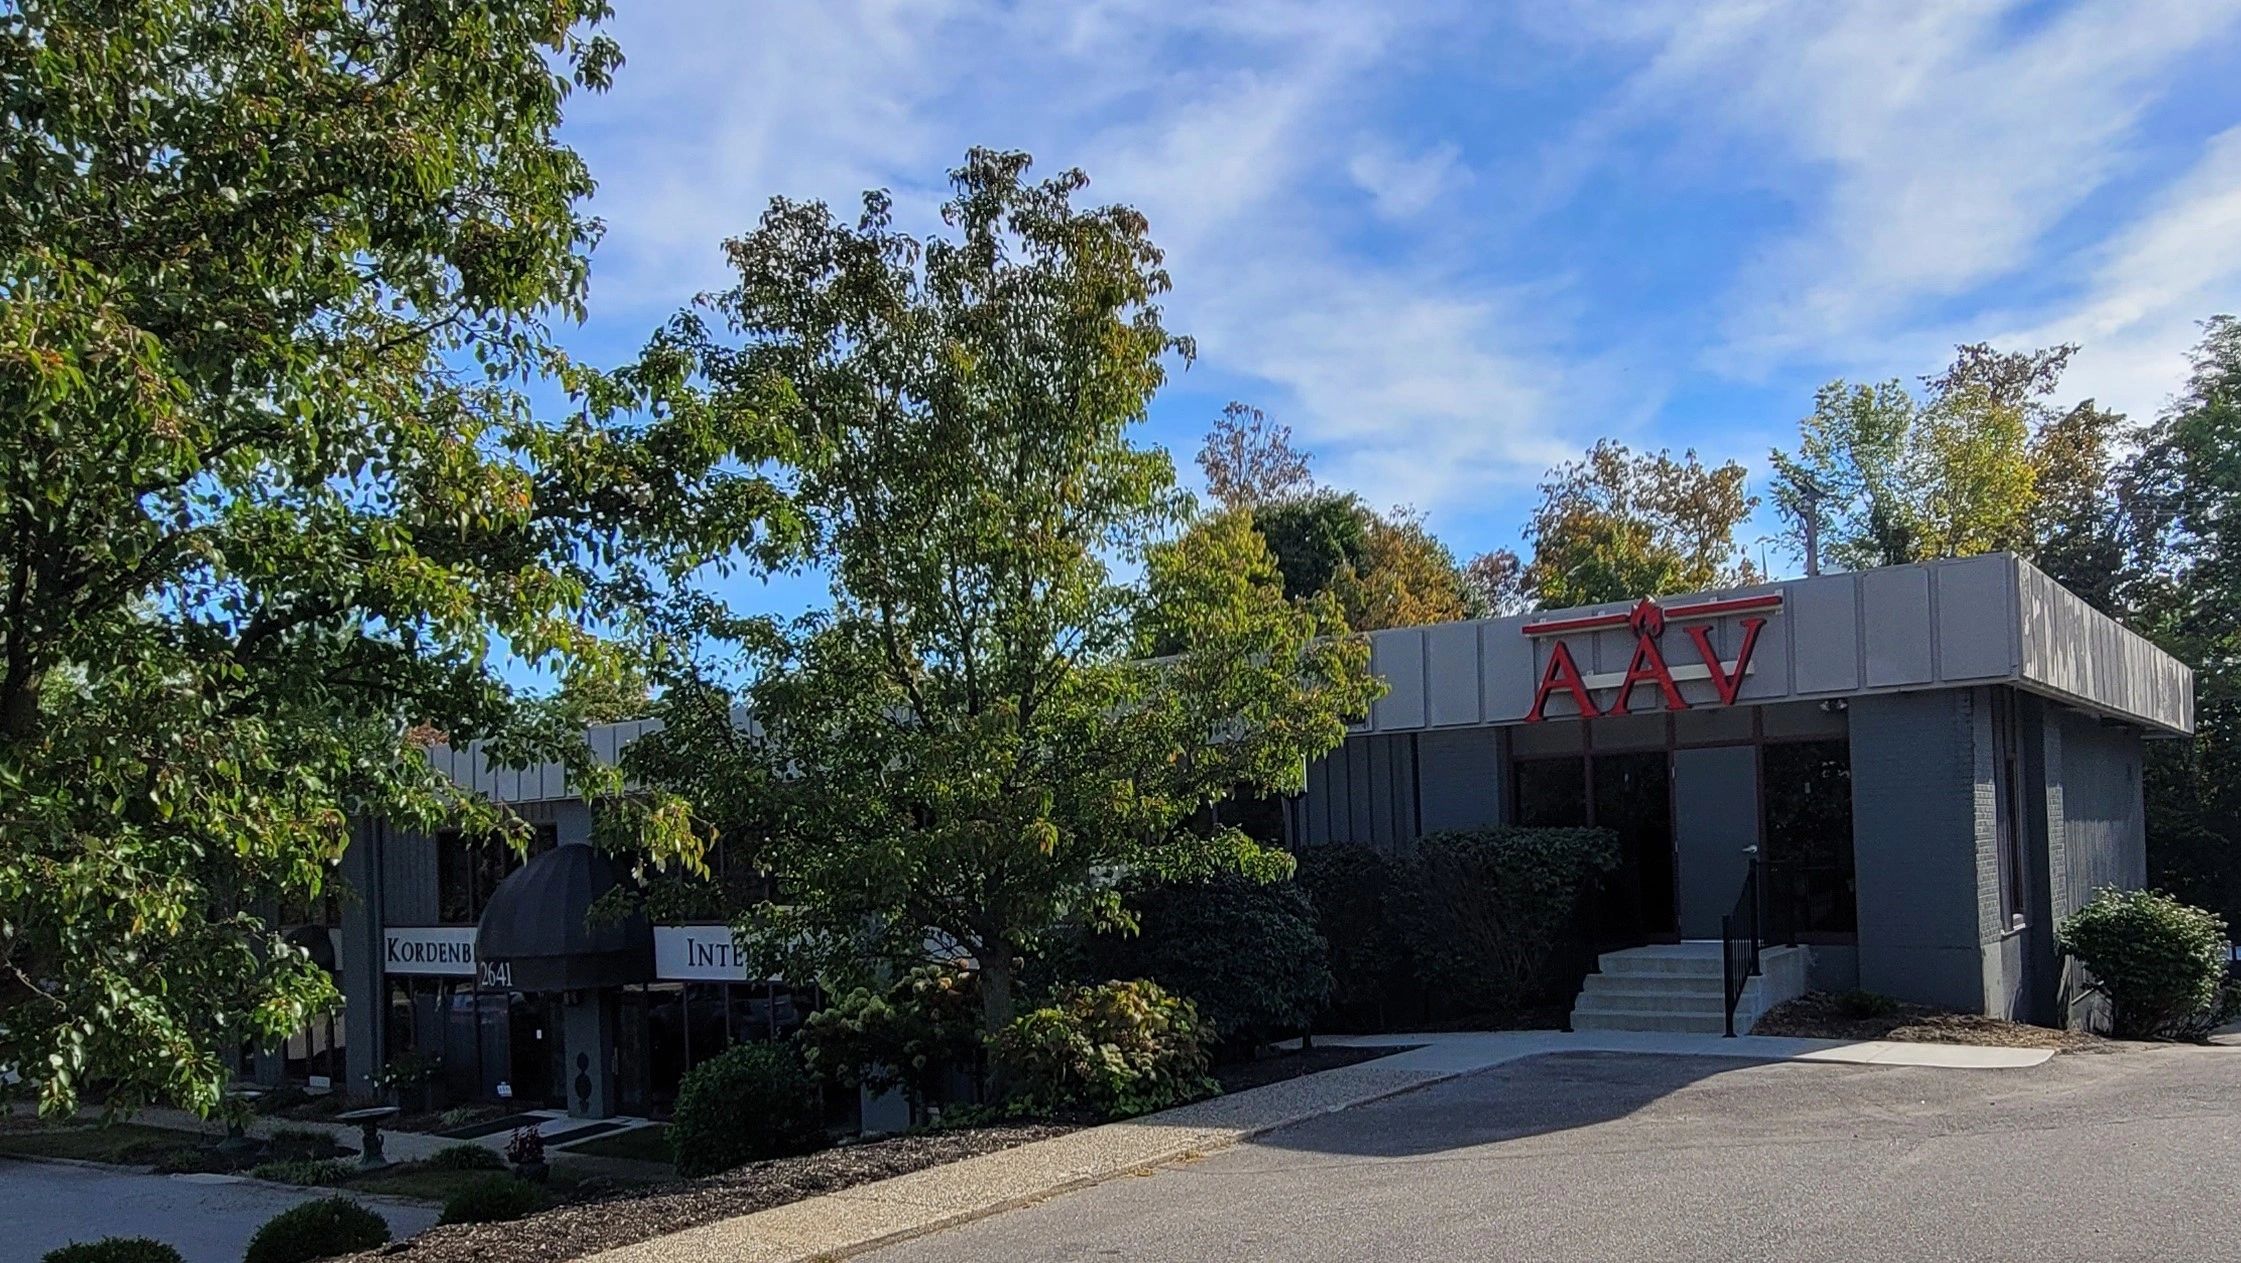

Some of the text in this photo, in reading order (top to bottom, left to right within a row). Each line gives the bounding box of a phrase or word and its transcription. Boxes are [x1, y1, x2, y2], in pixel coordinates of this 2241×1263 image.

[1523, 618, 1767, 722] AAV
[387, 938, 477, 963] KORDENB
[687, 938, 750, 967] INTE
[480, 961, 513, 987] 2641
